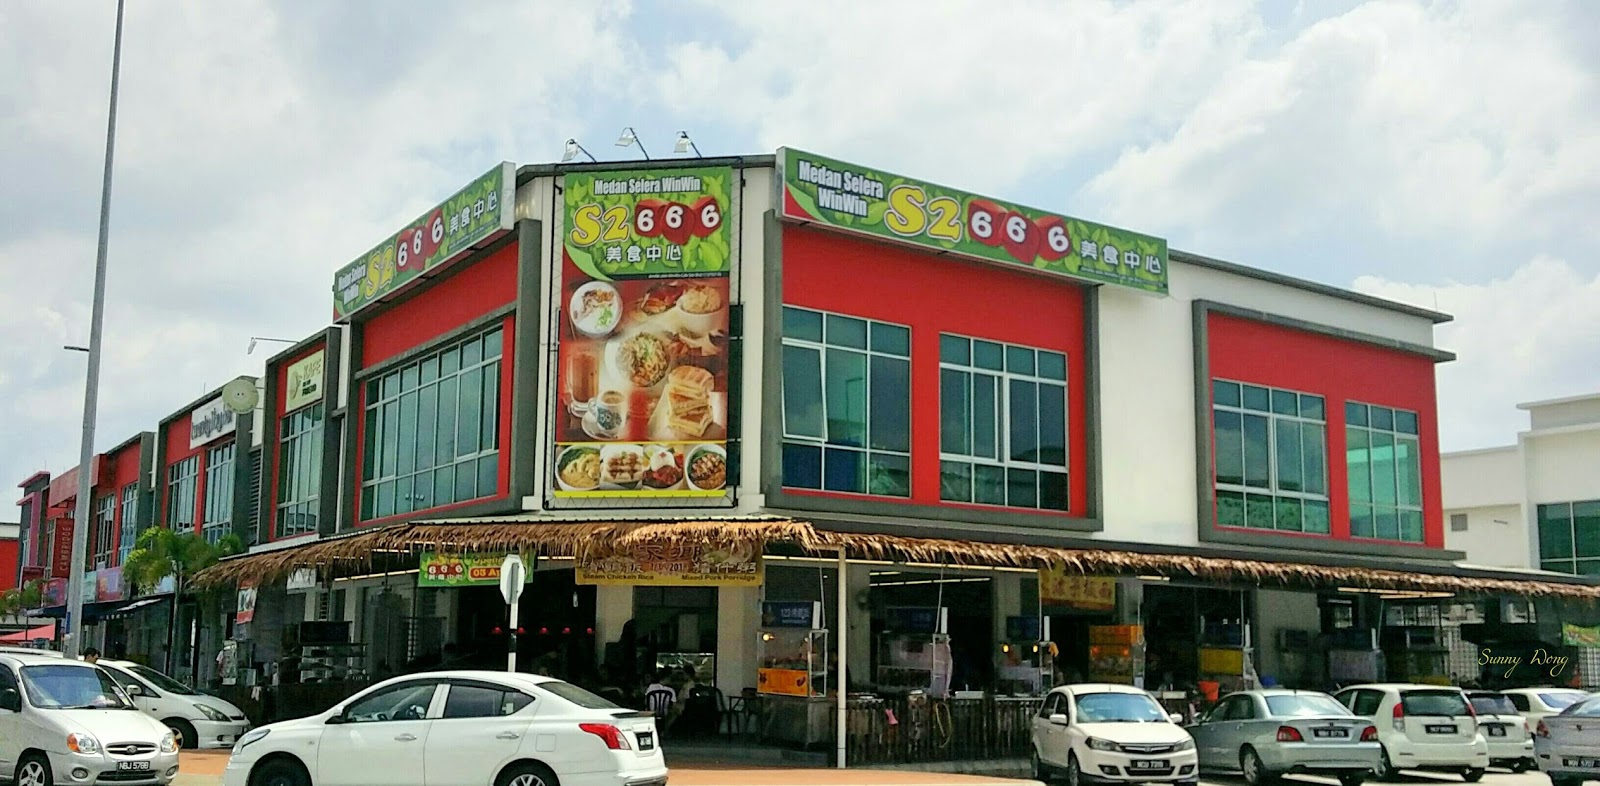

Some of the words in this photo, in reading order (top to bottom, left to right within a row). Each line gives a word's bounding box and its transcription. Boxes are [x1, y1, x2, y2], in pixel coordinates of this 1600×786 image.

[594, 180, 627, 195] Medan
[629, 179, 660, 194] Selera
[662, 177, 700, 192] WinWin
[799, 161, 842, 189] Medan
[844, 171, 884, 198] Selera
[450, 191, 498, 235] 美食中心
[818, 187, 868, 217] WinWin
[884, 185, 962, 243] S2
[570, 203, 630, 247] S2
[365, 245, 394, 299] S2
[606, 245, 682, 263] 美食中心
[1080, 239, 1161, 274] 美食中心
